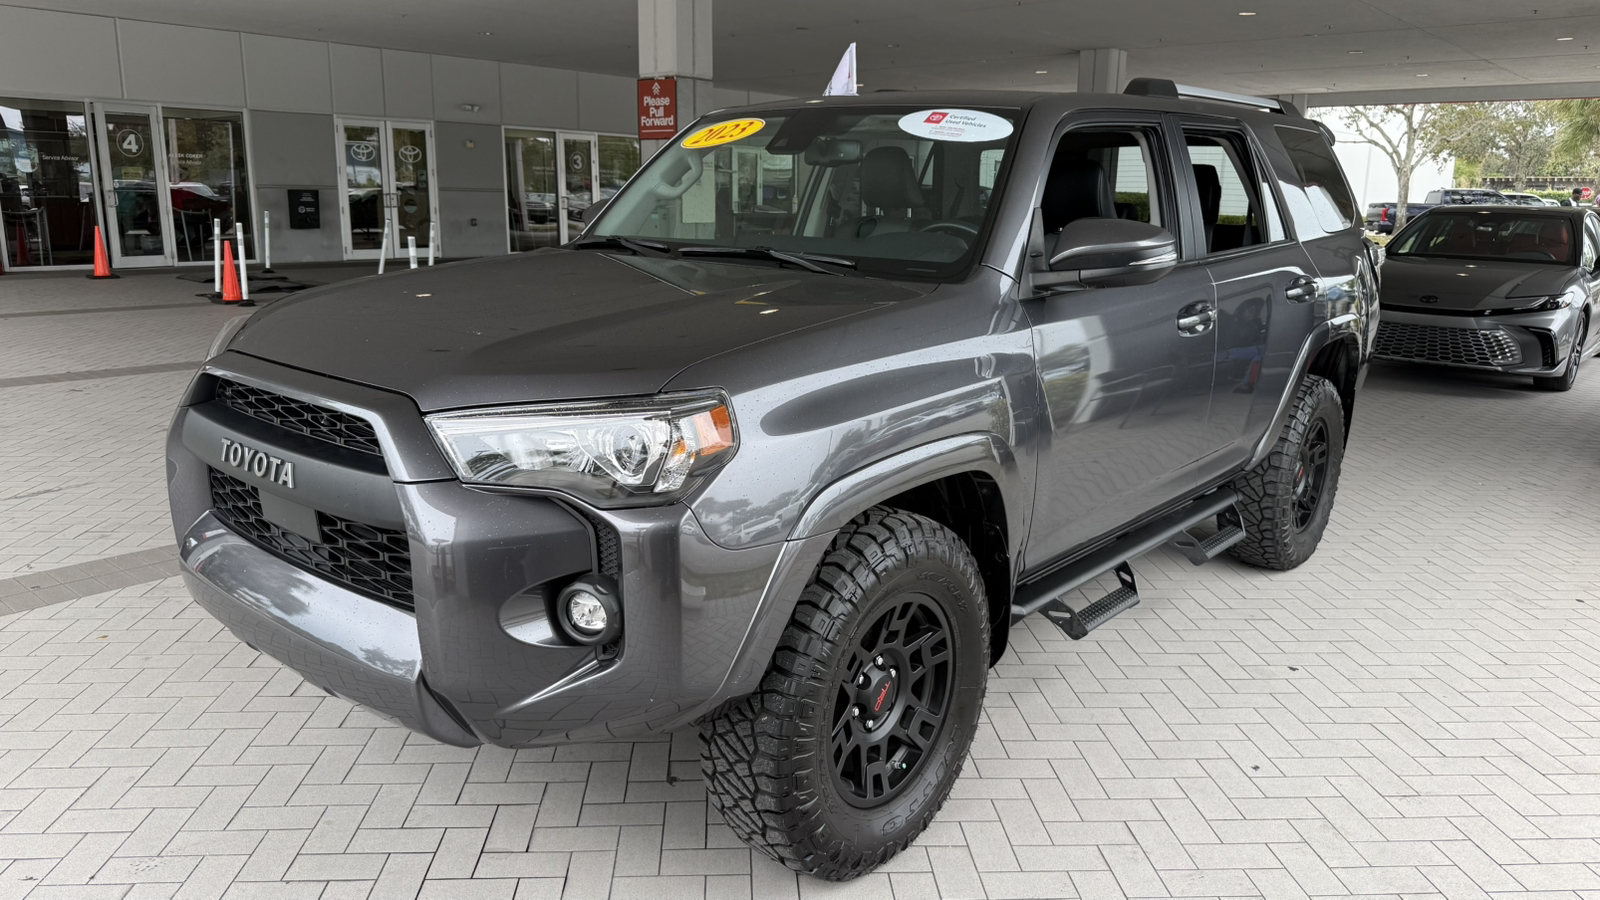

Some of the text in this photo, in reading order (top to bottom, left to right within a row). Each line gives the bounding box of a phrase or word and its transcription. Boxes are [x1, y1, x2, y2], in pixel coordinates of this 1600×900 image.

[643, 95, 670, 107] Please
[649, 106, 664, 118] Pull
[641, 115, 674, 126] Forward
[961, 120, 987, 128] Vehicles
[689, 121, 755, 145] 2023
[122, 133, 139, 153] 4
[573, 154, 583, 170] 3
[220, 437, 295, 489] TOYOTA
[874, 680, 891, 712] TRD
